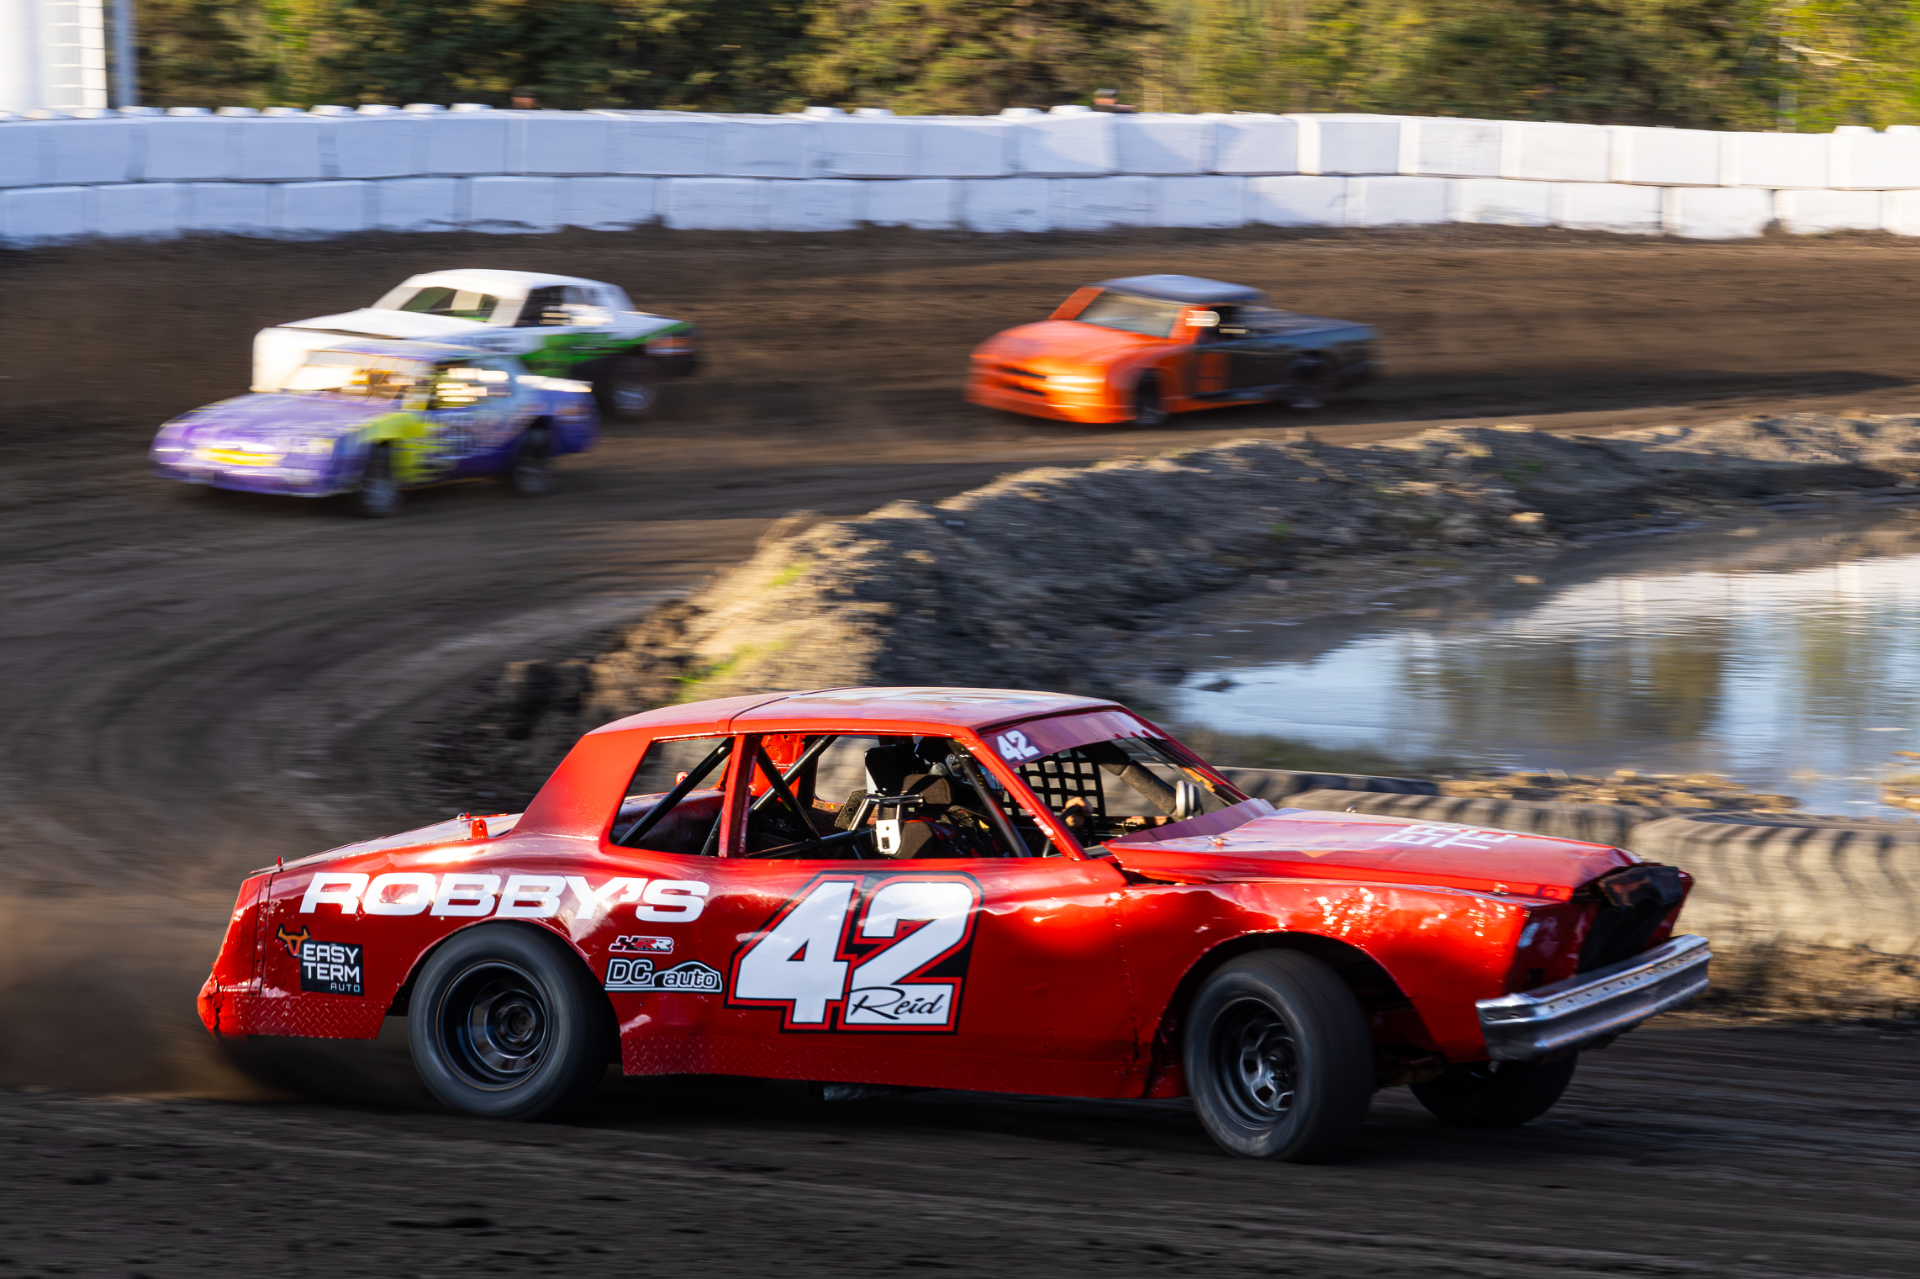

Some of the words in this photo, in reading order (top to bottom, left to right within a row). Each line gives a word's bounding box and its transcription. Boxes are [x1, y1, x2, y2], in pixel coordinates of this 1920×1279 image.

[996, 730, 1041, 761] 42
[298, 871, 710, 923] ROBBY'S
[303, 943, 359, 965] EASY
[733, 881, 974, 1025] 42
[302, 961, 360, 984] TERM
[330, 982, 361, 993] AUTO
[605, 958, 654, 985] DC
[662, 968, 718, 989] auto
[849, 986, 945, 1021] Reid
